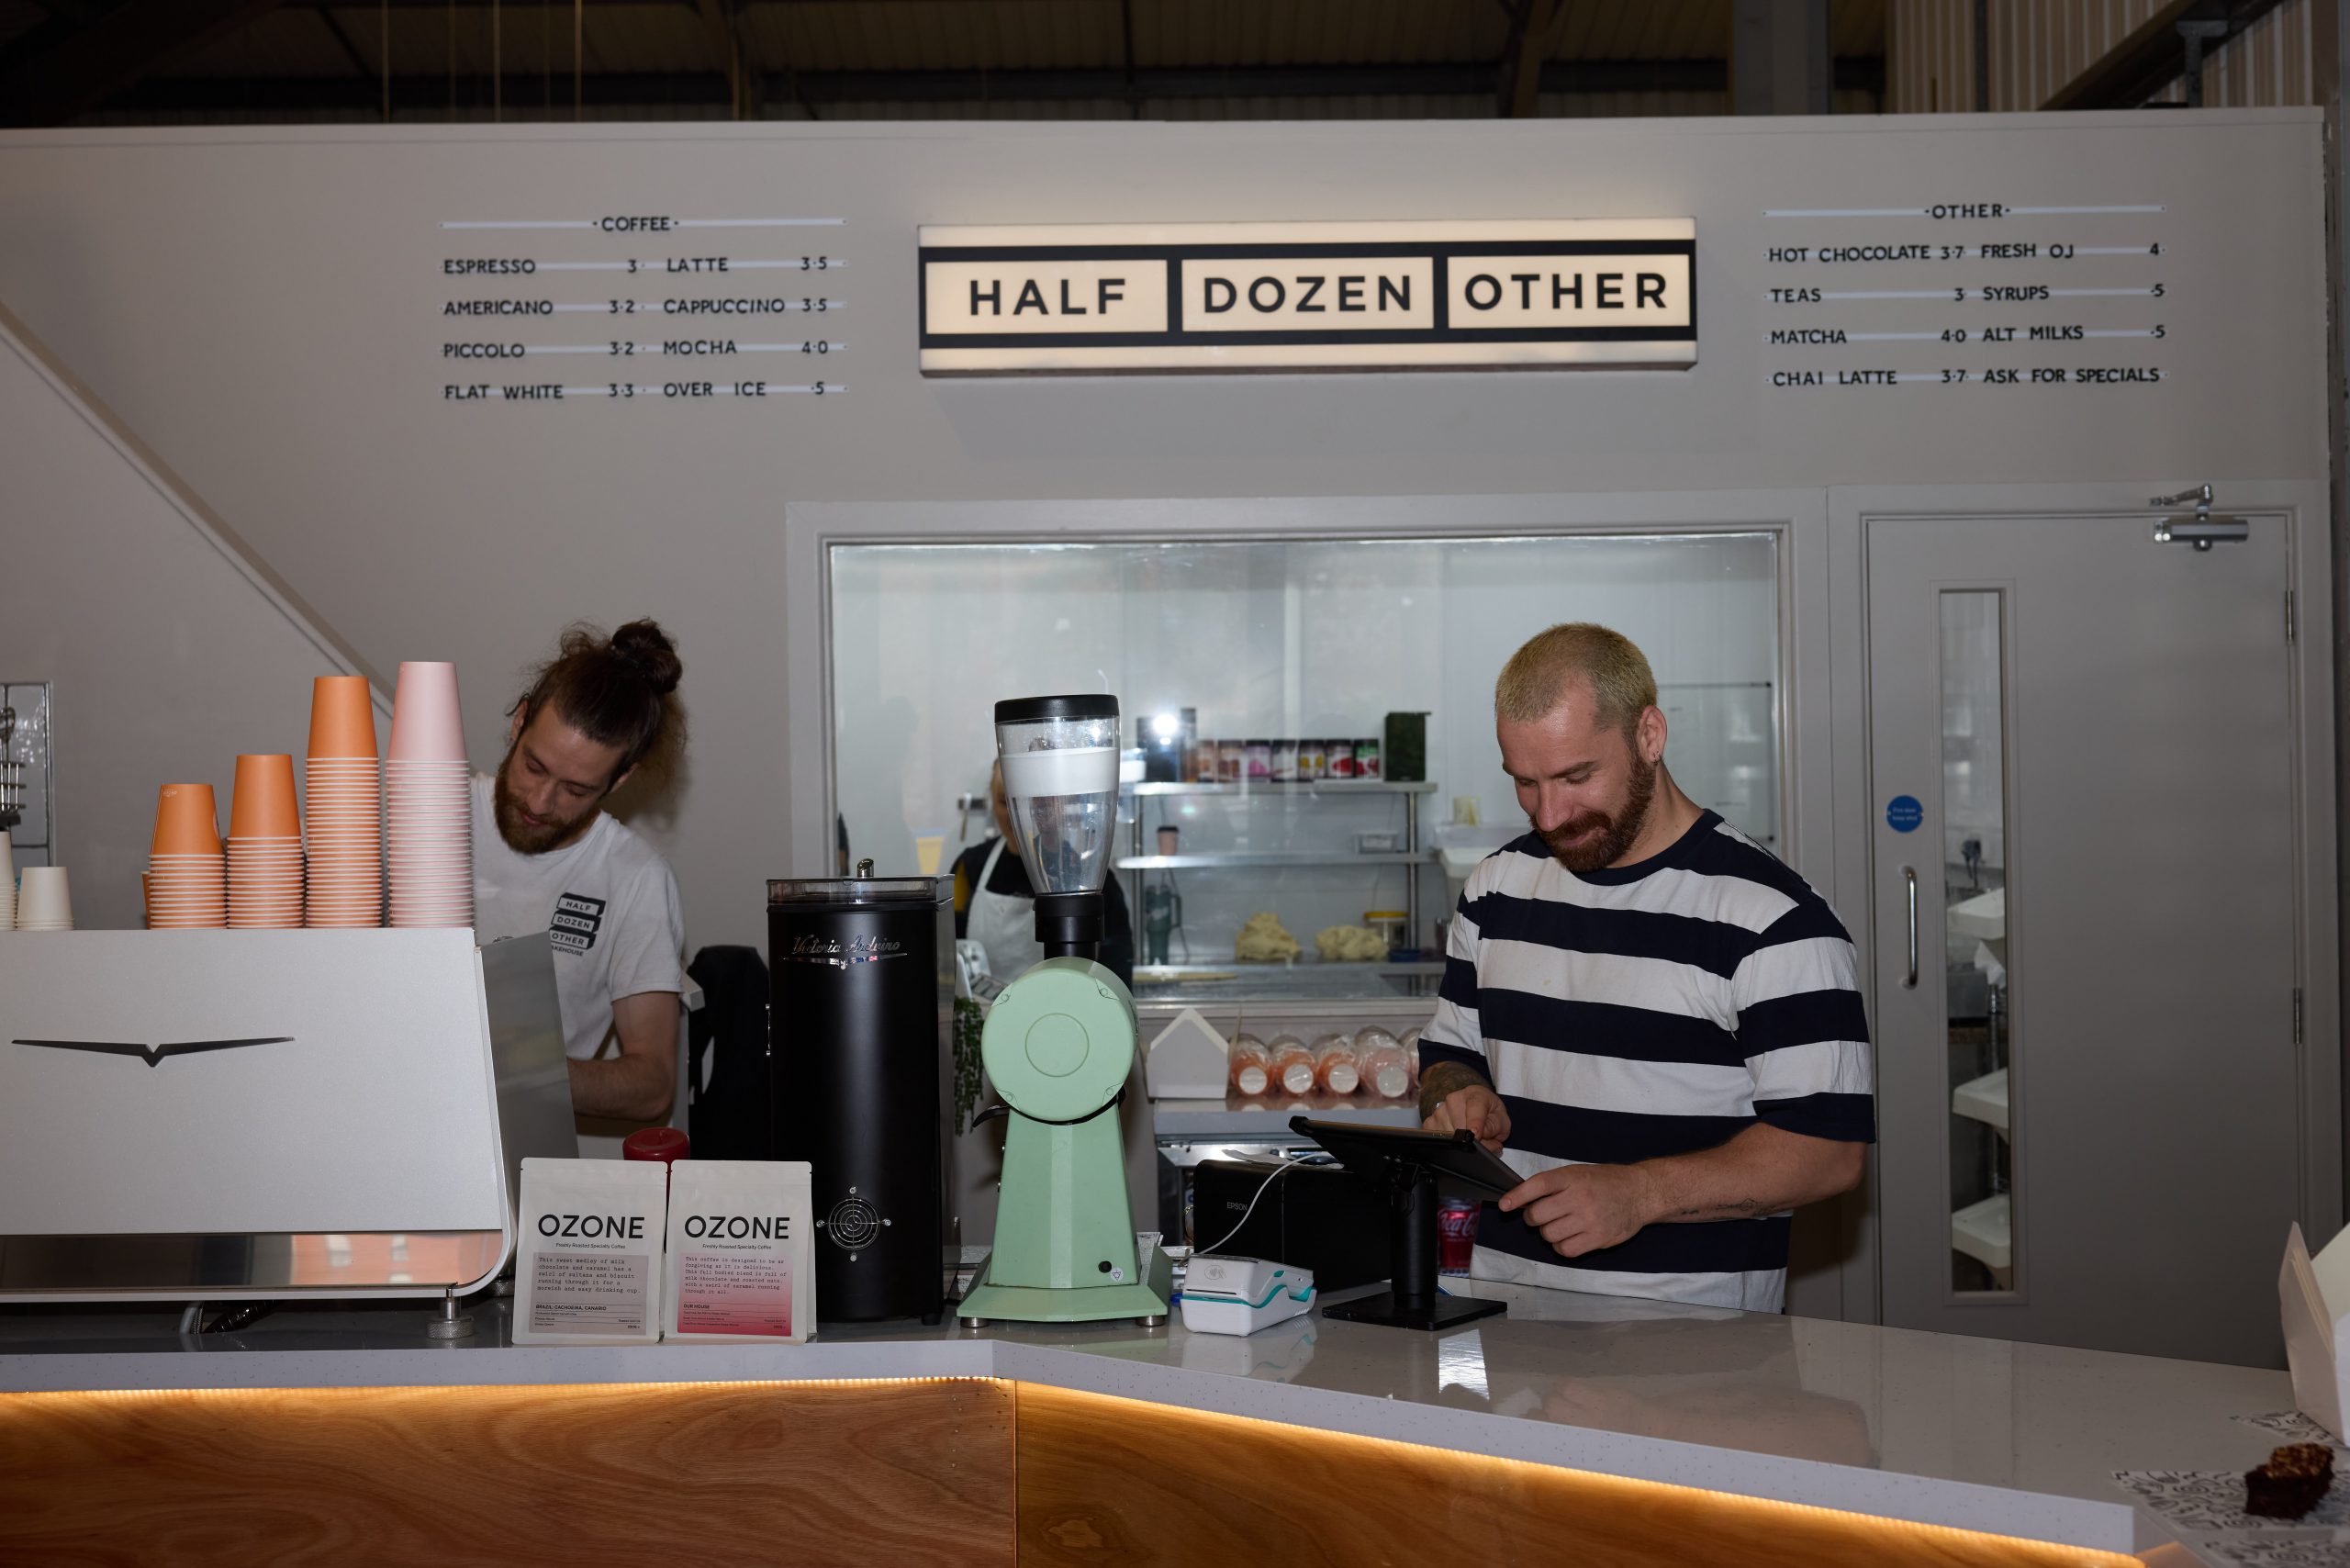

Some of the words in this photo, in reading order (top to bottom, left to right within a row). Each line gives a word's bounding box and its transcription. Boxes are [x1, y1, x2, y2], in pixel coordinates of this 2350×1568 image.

[1932, 204, 2002, 218] OTHER
[602, 217, 669, 231] COFFEE
[1770, 248, 1808, 263] HOT
[1819, 245, 1930, 263] CHOCOLATE
[1982, 244, 2036, 258] FRESH
[2050, 244, 2073, 259] OJ
[2150, 243, 2159, 255] 4
[444, 260, 535, 274] ESPRESSO
[628, 260, 636, 274] 3
[667, 257, 728, 272] LATTE
[970, 279, 1125, 315] HALF
[1204, 275, 1410, 313] DOZEN
[1465, 273, 1666, 310] OTHER
[1771, 288, 1820, 303] TEAS
[1955, 288, 1964, 301] 3
[1984, 286, 2049, 301] SYRUPS
[444, 300, 553, 315] AMERICANO
[664, 298, 784, 314] CAPPUCCINO
[1772, 330, 1847, 343] MATCHA
[1983, 328, 2016, 342] ALT
[2031, 326, 2083, 340] MILKS
[444, 343, 524, 358] PICCOLO
[664, 341, 736, 355] MOCHA
[1774, 372, 1822, 386] CHAI
[1840, 371, 1897, 385] LATTE
[1984, 369, 2019, 384] ASK
[2032, 368, 2065, 382] FOR
[2076, 368, 2159, 383] SPECIALS
[445, 385, 489, 399] FLAT
[503, 385, 563, 399] WHITE
[664, 382, 712, 397] OVER
[735, 382, 766, 397] ICE
[565, 901, 591, 912] HALF
[556, 916, 590, 929] DOZEN
[552, 933, 585, 946] OTHER
[552, 946, 584, 957] AKEHOUSE
[1226, 1202, 1248, 1211] EPSON
[538, 1215, 644, 1238] OZONE
[685, 1215, 789, 1239] OZONE
